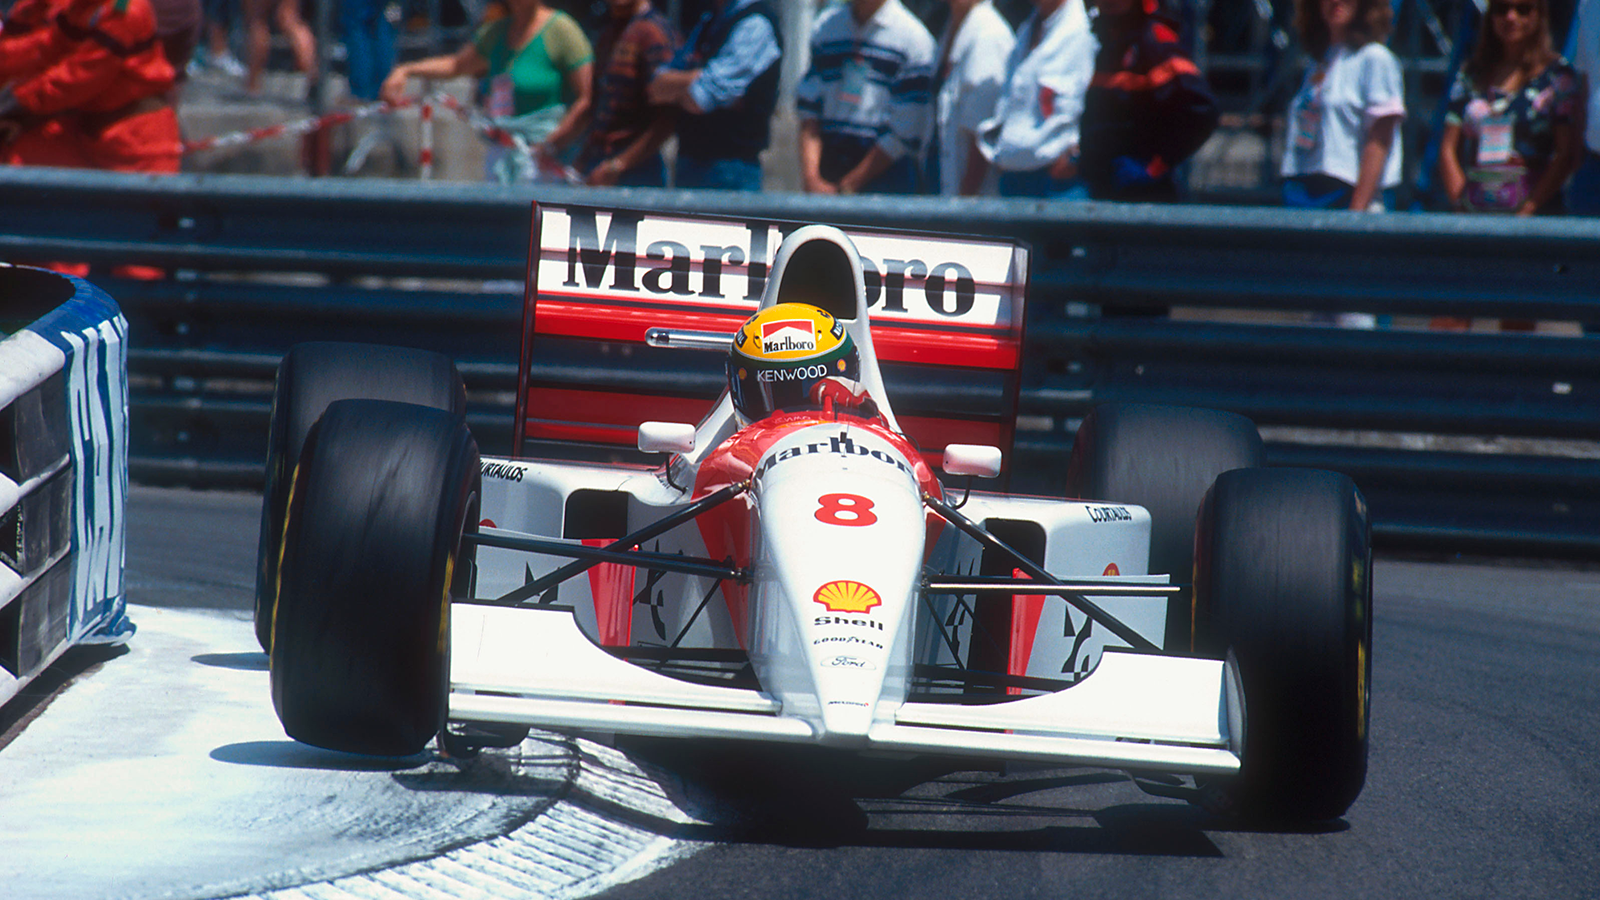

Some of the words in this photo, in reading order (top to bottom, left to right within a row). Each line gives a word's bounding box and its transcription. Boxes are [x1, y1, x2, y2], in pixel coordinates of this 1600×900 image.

[561, 207, 976, 317] Marlro
[764, 336, 814, 353] Marlboro
[757, 364, 828, 382] KENWOOD
[752, 436, 916, 482] Marlbor
[814, 492, 878, 527] 8
[814, 616, 884, 631] Shell
[813, 636, 884, 650] GOODYEAR
[831, 655, 866, 668] Ford
